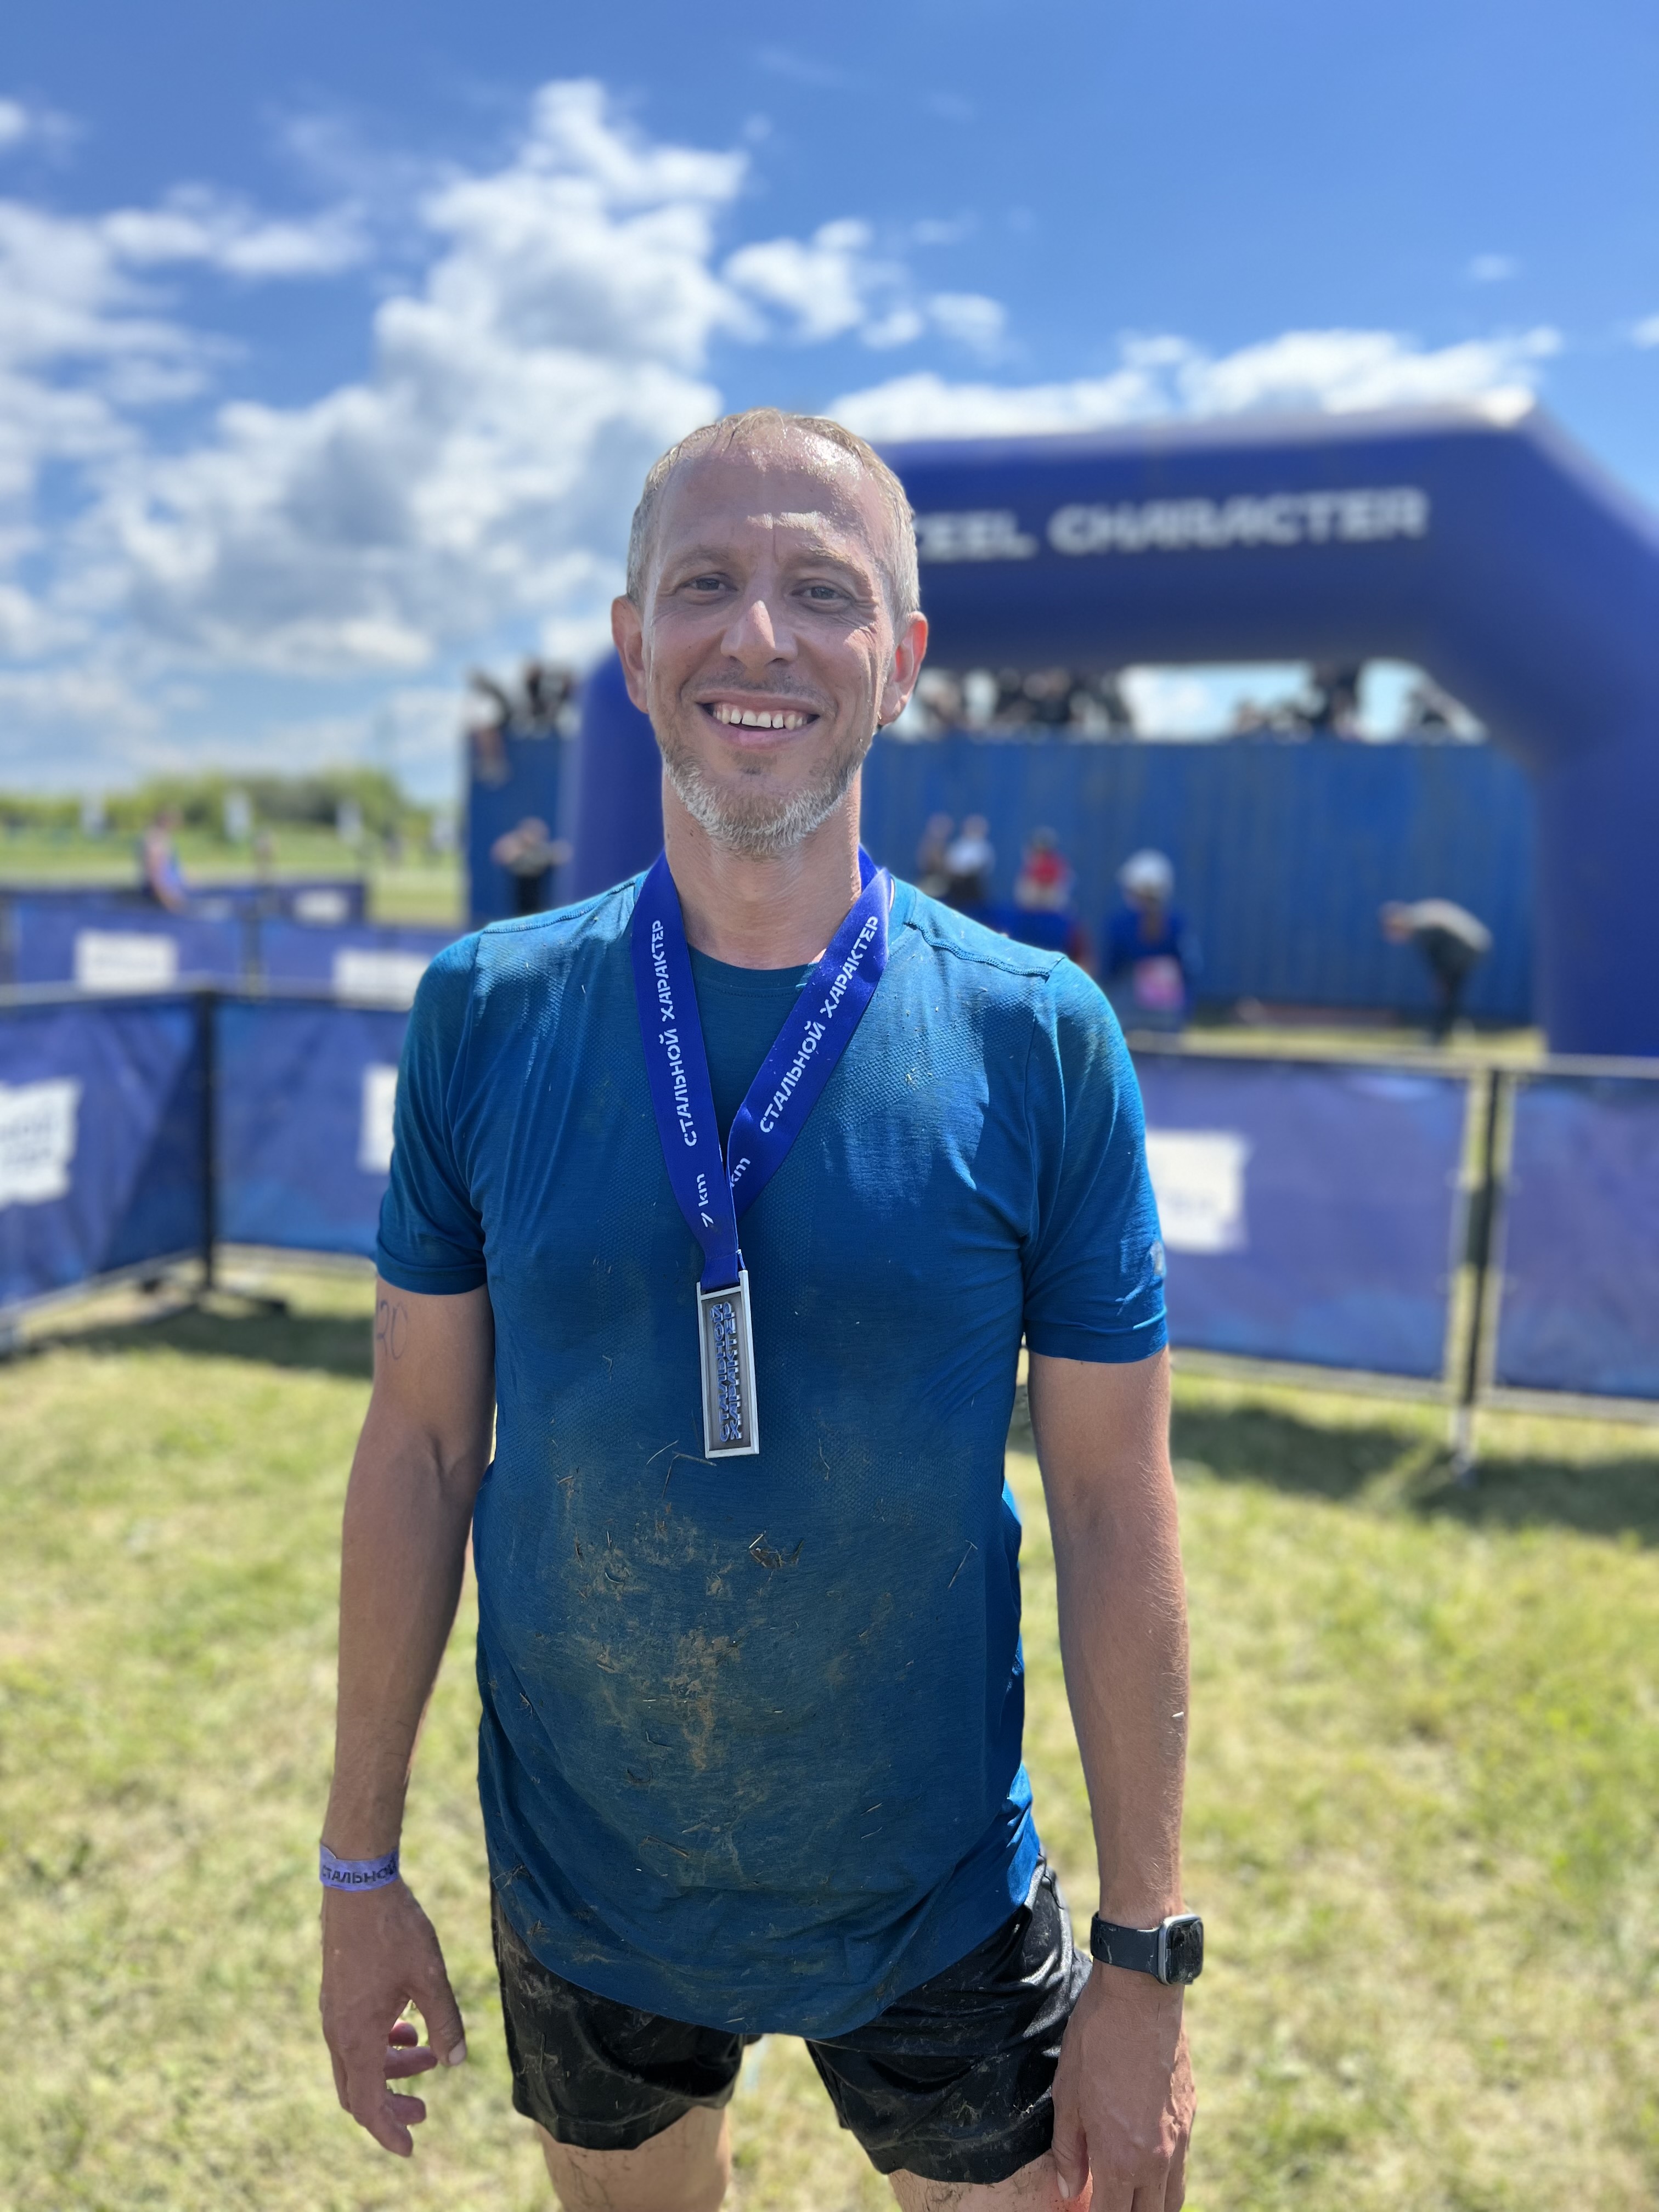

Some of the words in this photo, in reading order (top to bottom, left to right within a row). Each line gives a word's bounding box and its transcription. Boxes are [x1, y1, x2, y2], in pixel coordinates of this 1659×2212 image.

[913, 509, 1038, 561] EEL
[1047, 487, 1429, 555] CHARACTER
[651, 919, 676, 1022] ХАРАКТЕР
[759, 1020, 826, 1133] СТАЛЬНОЙ
[819, 915, 879, 1019] ХАРАКТЕР
[659, 1028, 697, 1147] СТАЛЬНОЙ
[696, 1172, 709, 1207] km
[709, 1303, 730, 1442] СТАЛЬНОЙ
[722, 1301, 742, 1441] ХАРАКТЕР
